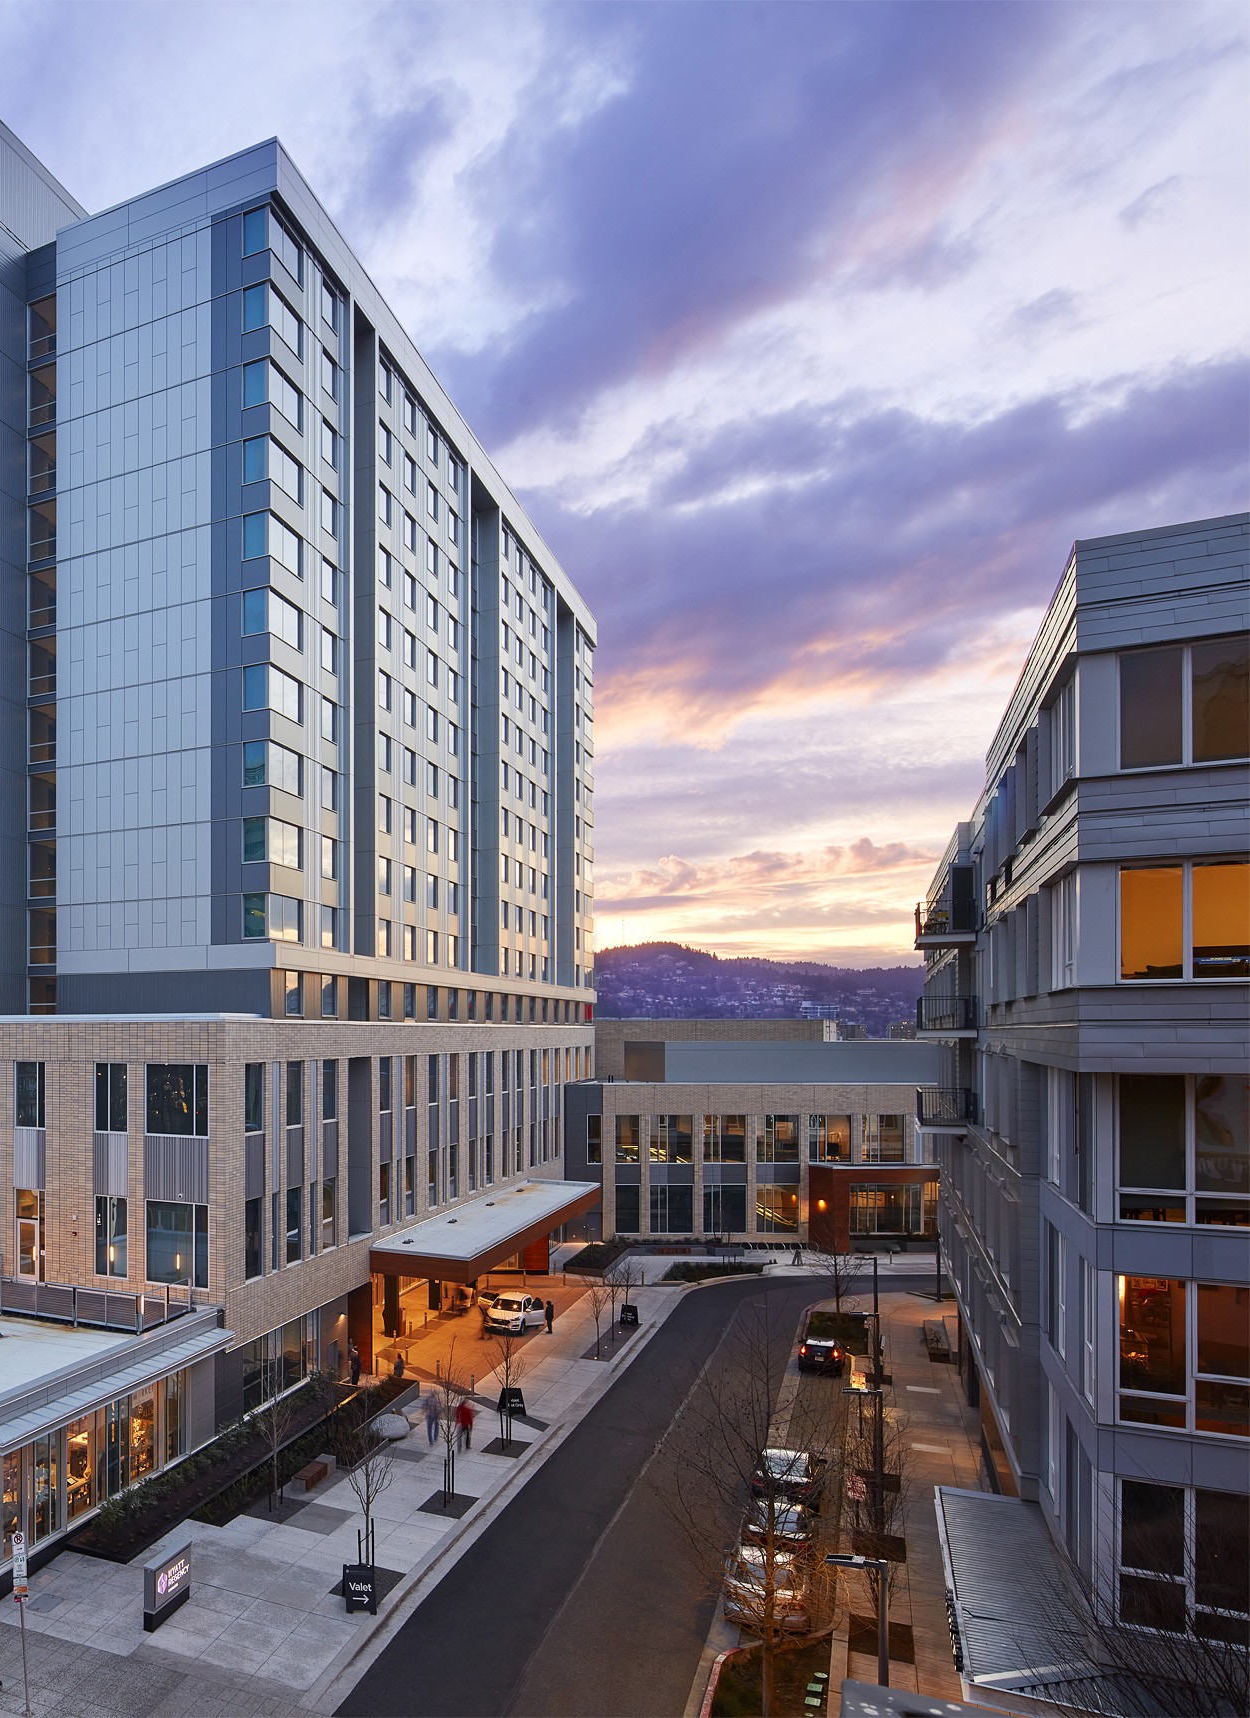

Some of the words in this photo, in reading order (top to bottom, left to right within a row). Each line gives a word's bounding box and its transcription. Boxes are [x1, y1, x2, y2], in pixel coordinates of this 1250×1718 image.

[168, 1559, 185, 1578] HYATT
[168, 1564, 190, 1587] REGENCY
[349, 1582, 372, 1592] Valet
